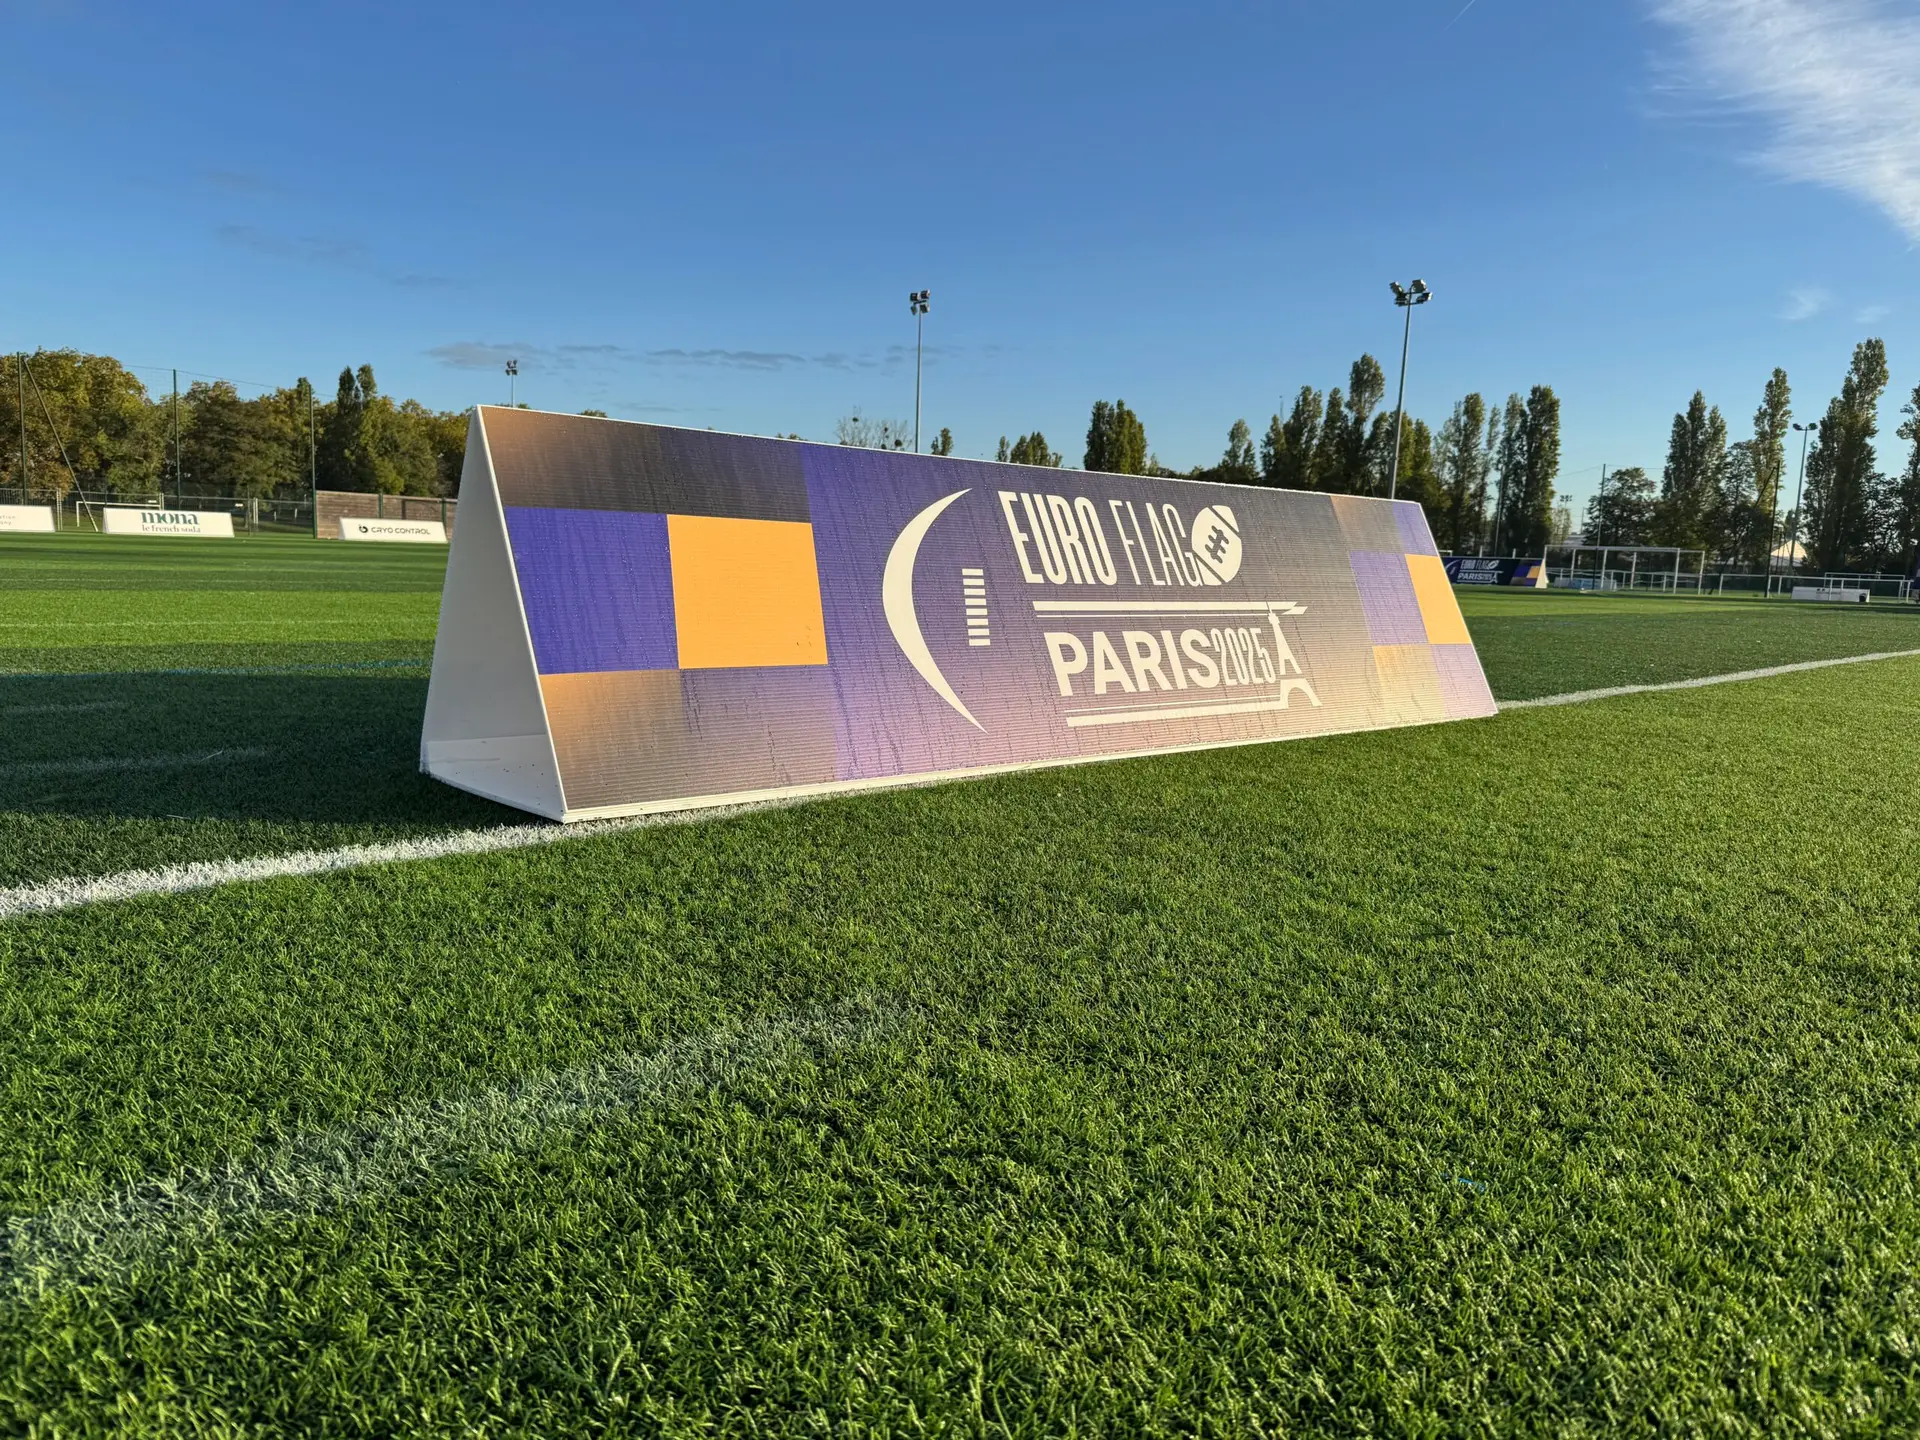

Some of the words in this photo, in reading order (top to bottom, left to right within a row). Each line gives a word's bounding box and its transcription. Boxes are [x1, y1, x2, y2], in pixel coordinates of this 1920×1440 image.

[141, 512, 199, 525] mona
[371, 526, 394, 534] CRYO
[394, 527, 431, 535] CONTROL
[998, 490, 1117, 586] EURO
[1109, 499, 1202, 588] FLAG
